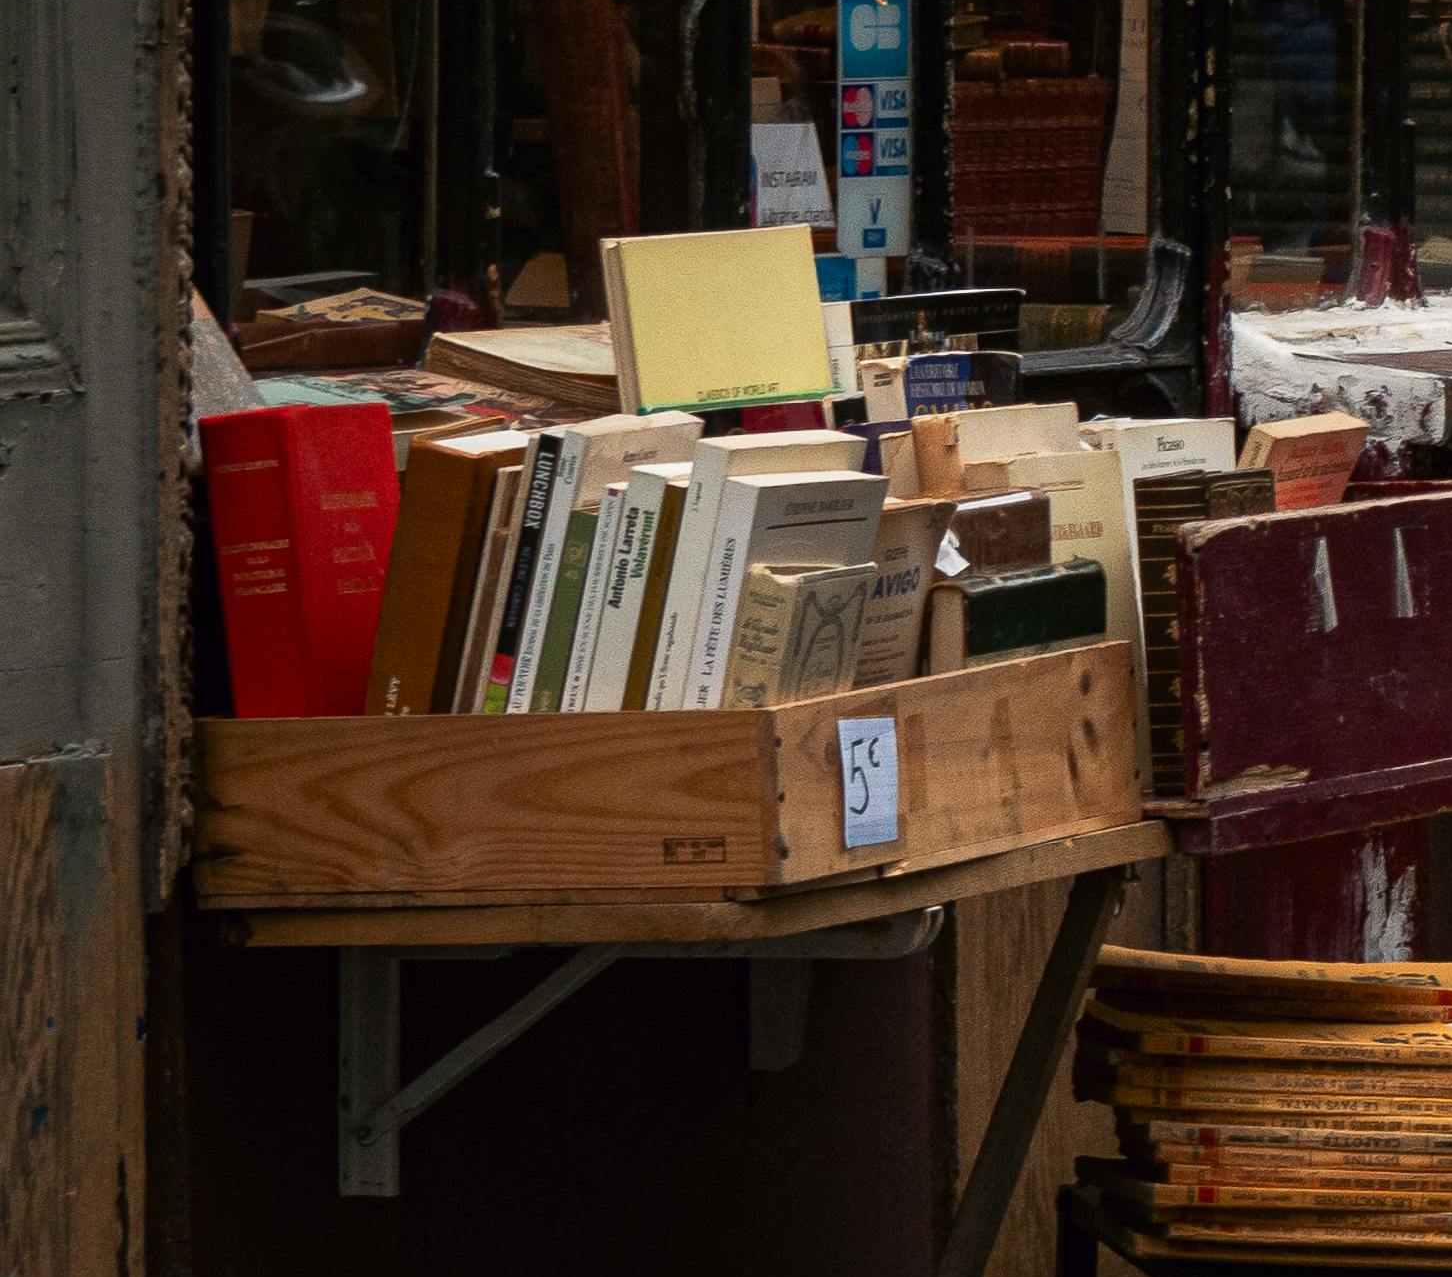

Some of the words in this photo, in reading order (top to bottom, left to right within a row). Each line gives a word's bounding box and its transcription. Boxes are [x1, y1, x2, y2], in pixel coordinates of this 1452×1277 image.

[880, 88, 908, 111] VISA
[880, 136, 908, 159] VISA
[523, 450, 556, 530] LUNCHBOX
[615, 504, 641, 555] Larreta
[625, 508, 660, 580] Volaverunt
[605, 556, 631, 609] Antonio
[700, 658, 714, 675] LA
[709, 600, 725, 625] DES
